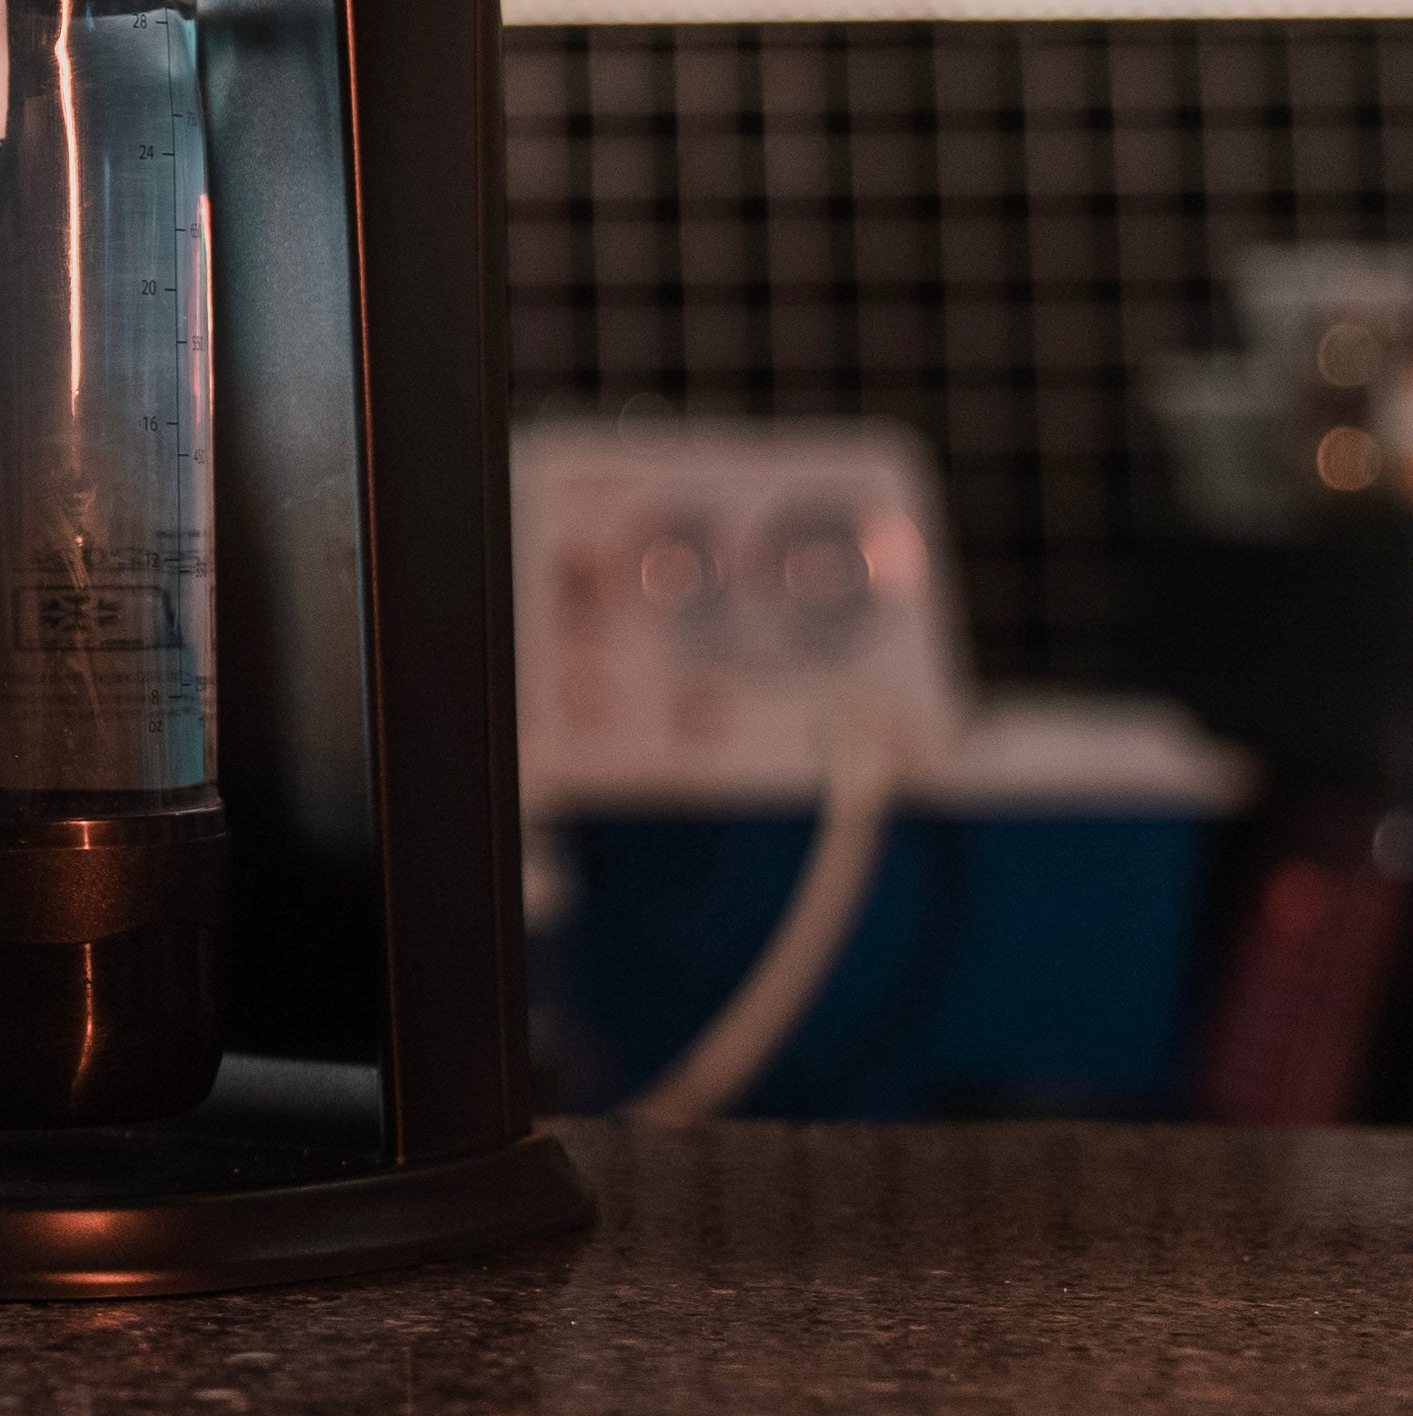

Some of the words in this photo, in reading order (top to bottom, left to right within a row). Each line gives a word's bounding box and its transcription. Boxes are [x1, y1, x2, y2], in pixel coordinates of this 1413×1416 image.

[132, 14, 147, 30] 28
[139, 144, 154, 160] 24
[141, 279, 157, 296] 20
[143, 416, 158, 432] 16
[151, 689, 158, 705] 8
